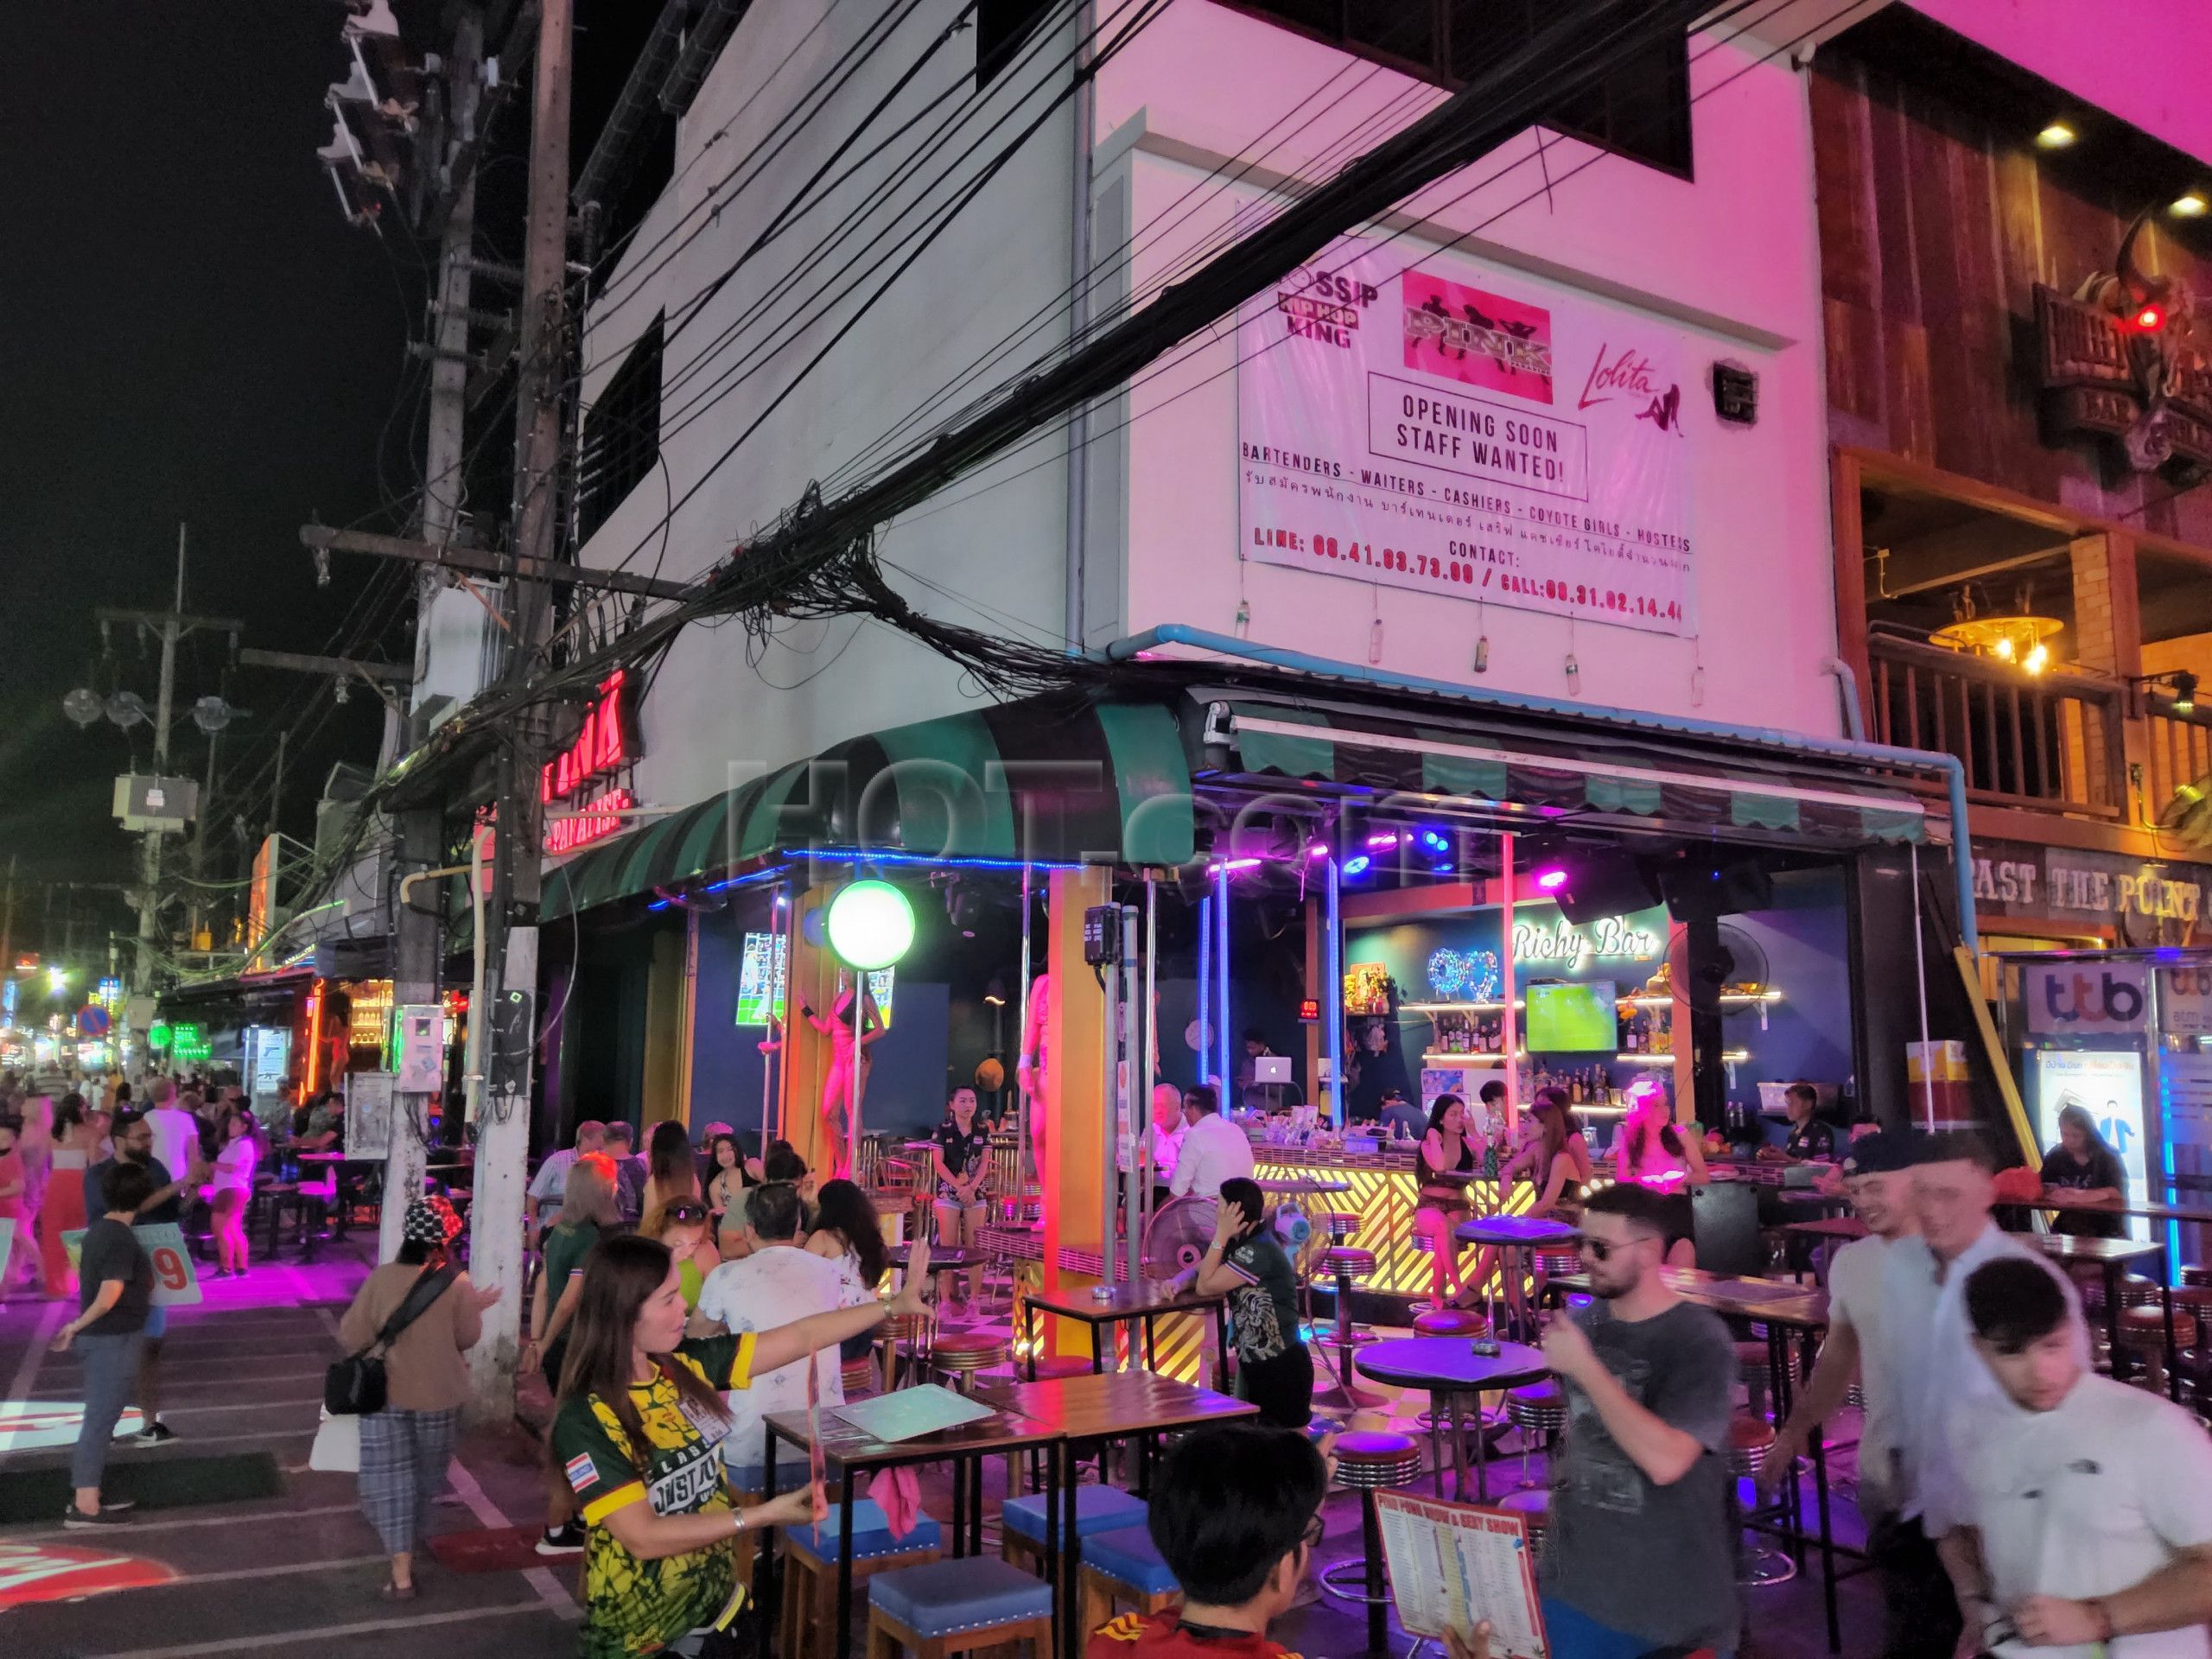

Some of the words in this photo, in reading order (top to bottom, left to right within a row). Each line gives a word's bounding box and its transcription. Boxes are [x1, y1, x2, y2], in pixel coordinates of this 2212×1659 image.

[1287, 315, 1351, 348] KING
[1405, 306, 1552, 372] PINK
[1578, 342, 1659, 410] Lolita
[1396, 423, 1463, 460] STAFF
[1471, 441, 1566, 483] WANTED!
[1402, 394, 1496, 437] OPENING
[1505, 420, 1558, 453] SOON
[1243, 442, 1341, 477] BARTENDERS
[1361, 469, 1424, 496] WAITERS
[1445, 487, 1510, 514] CASHIERS
[1529, 506, 1578, 528] COYOTE
[1584, 518, 1619, 537] GIRLS
[1637, 529, 1690, 552] HOSTESS
[1255, 527, 1305, 552] LINE:
[1449, 541, 1520, 568] CONTACT:
[1971, 859, 2037, 904] AST
[2052, 868, 2109, 911] THE
[2119, 874, 2202, 922] POINT
[1512, 920, 1583, 969] Richy
[1595, 917, 1654, 956] Bar
[2044, 972, 2143, 1023] ttb
